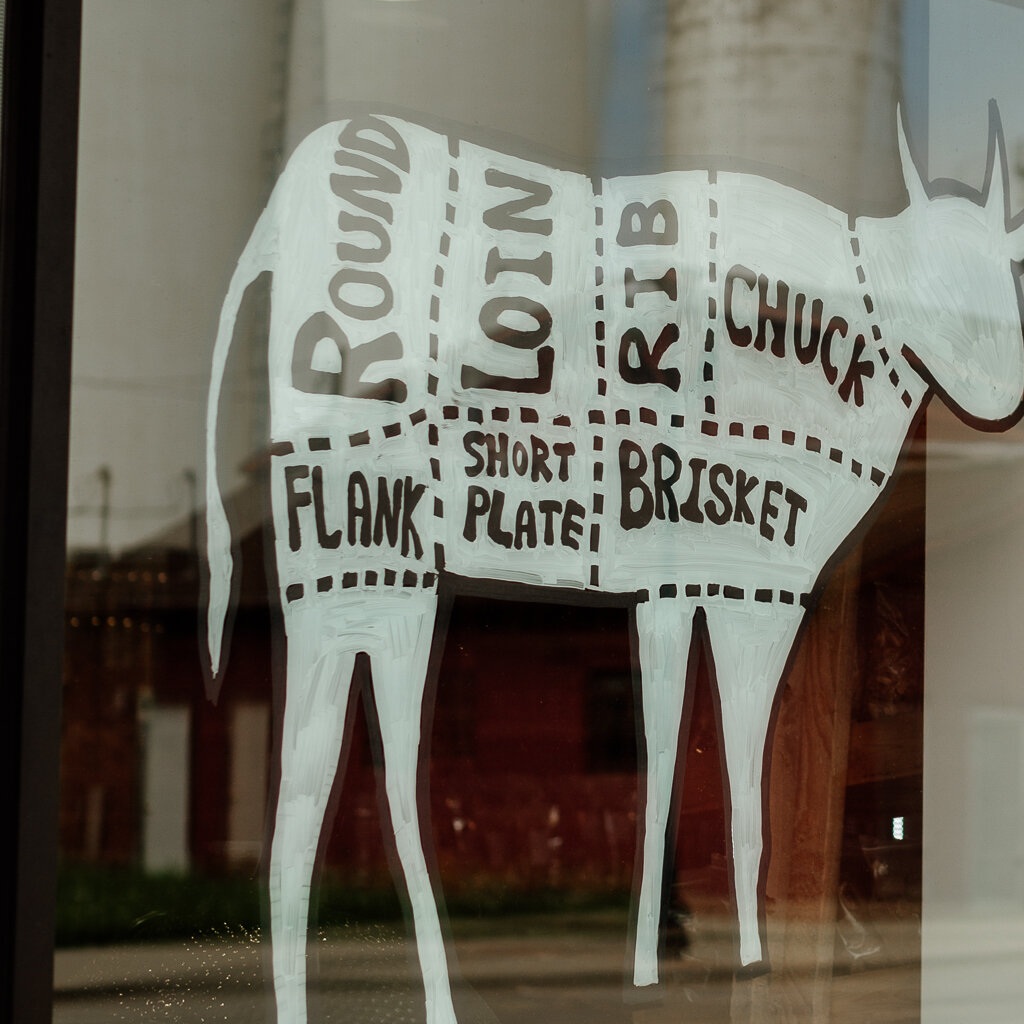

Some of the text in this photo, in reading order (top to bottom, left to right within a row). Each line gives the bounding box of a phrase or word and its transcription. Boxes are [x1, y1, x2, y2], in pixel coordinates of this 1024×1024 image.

[291, 114, 411, 403] ROUND
[461, 168, 555, 394] LOIN
[616, 199, 681, 392] RIB
[724, 264, 875, 407] CHUCK
[284, 465, 430, 560] FLANK
[462, 431, 576, 483] SHORT
[463, 485, 586, 550] PLATE
[618, 439, 808, 547] BRISKET
